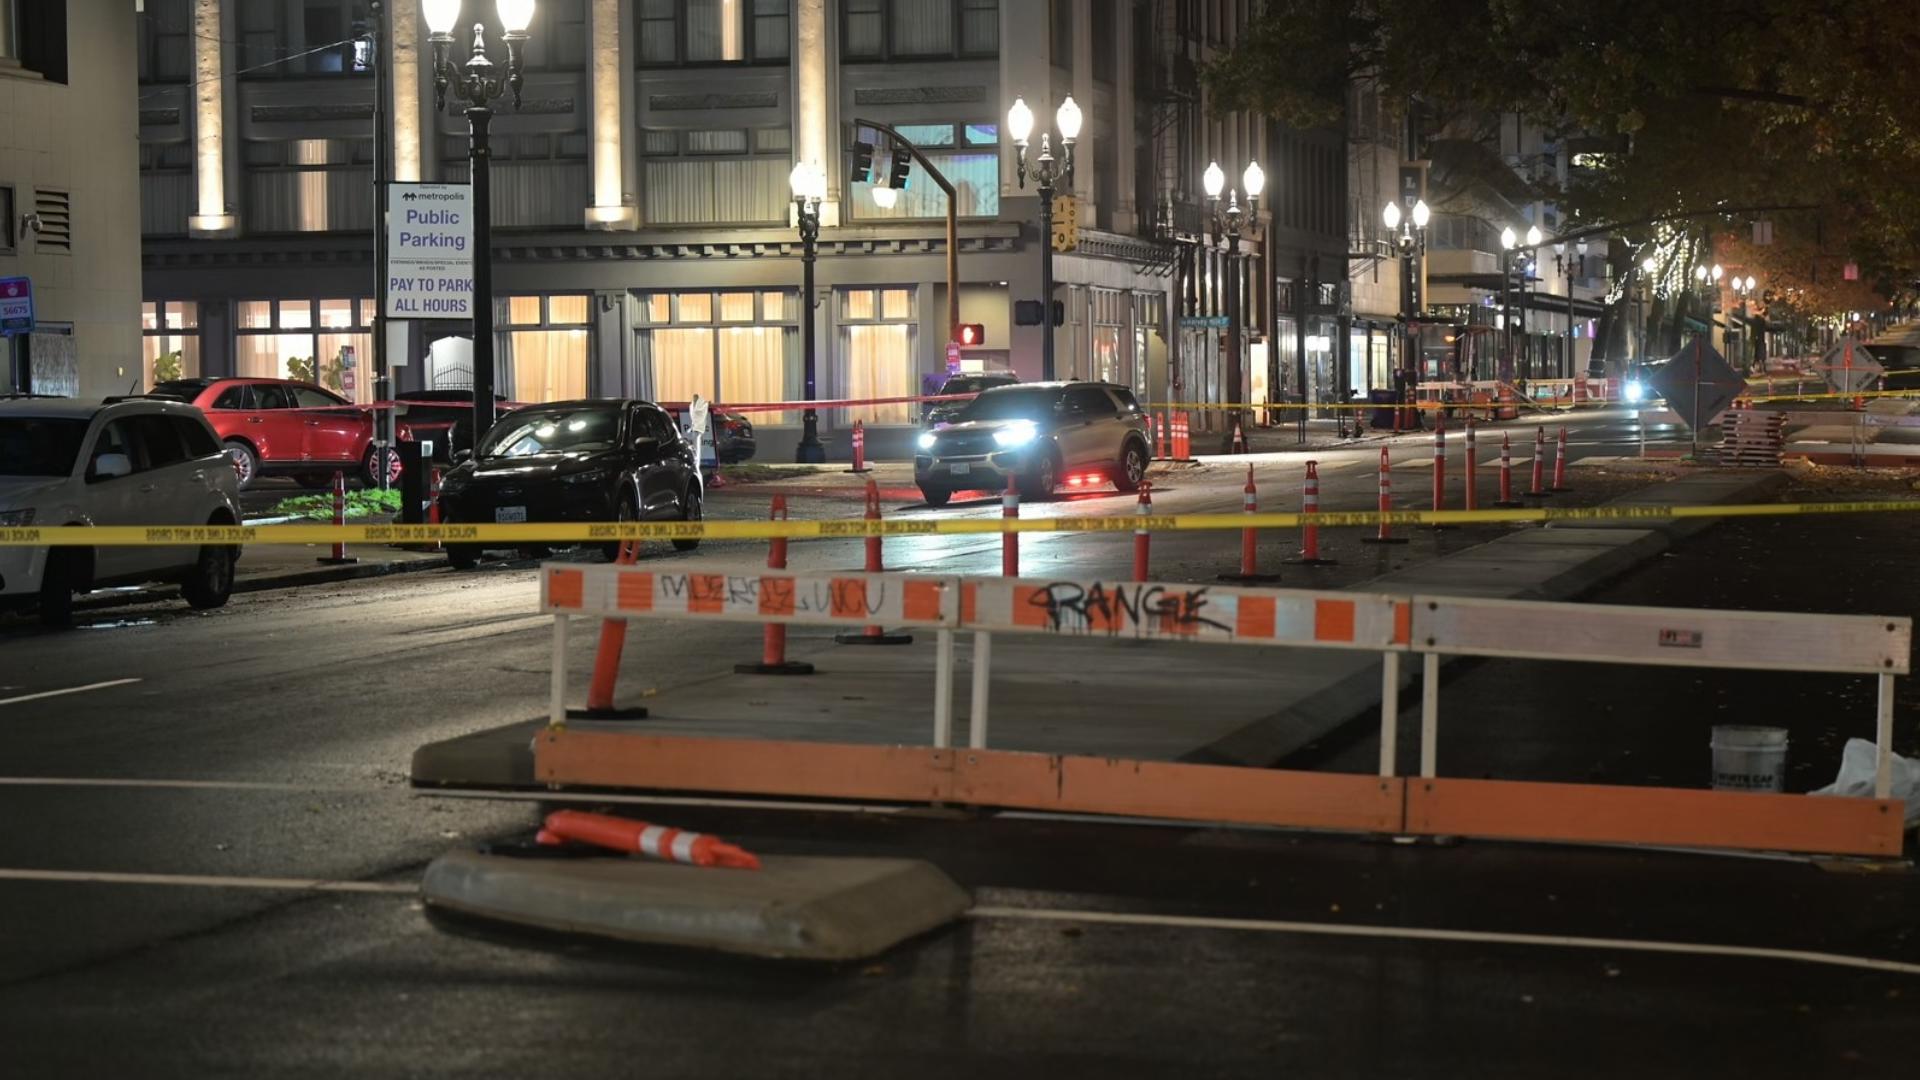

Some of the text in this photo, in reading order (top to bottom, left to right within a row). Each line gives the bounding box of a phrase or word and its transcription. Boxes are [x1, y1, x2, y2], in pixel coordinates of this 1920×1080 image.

[418, 192, 465, 202] metropolis
[406, 209, 460, 225] Public
[399, 231, 466, 251] Parking
[390, 278, 474, 292] PAY TO PARK
[395, 299, 467, 313] ALL HOURS
